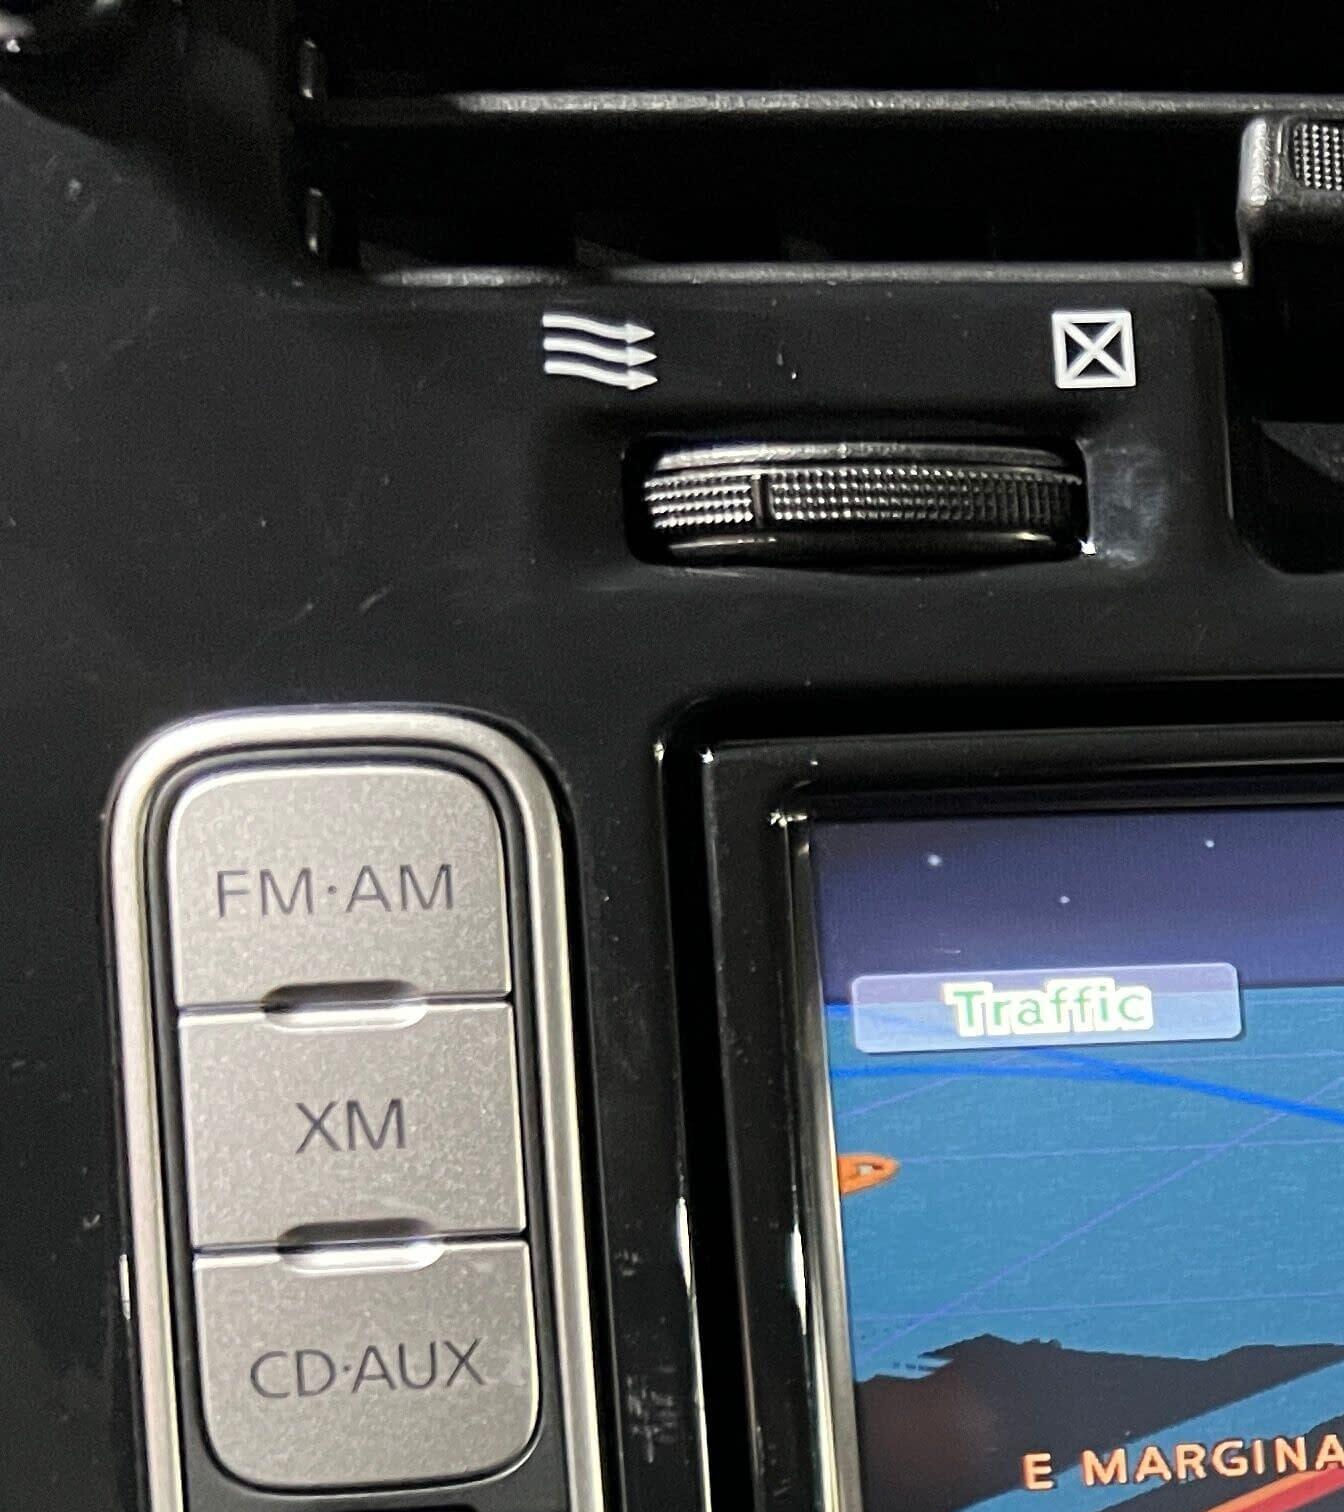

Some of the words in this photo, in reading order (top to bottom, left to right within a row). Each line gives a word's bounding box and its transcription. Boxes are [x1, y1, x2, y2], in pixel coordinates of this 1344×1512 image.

[948, 981, 1150, 1033] Traffic
[295, 1099, 406, 1152] XM
[1023, 1451, 1054, 1491] E
